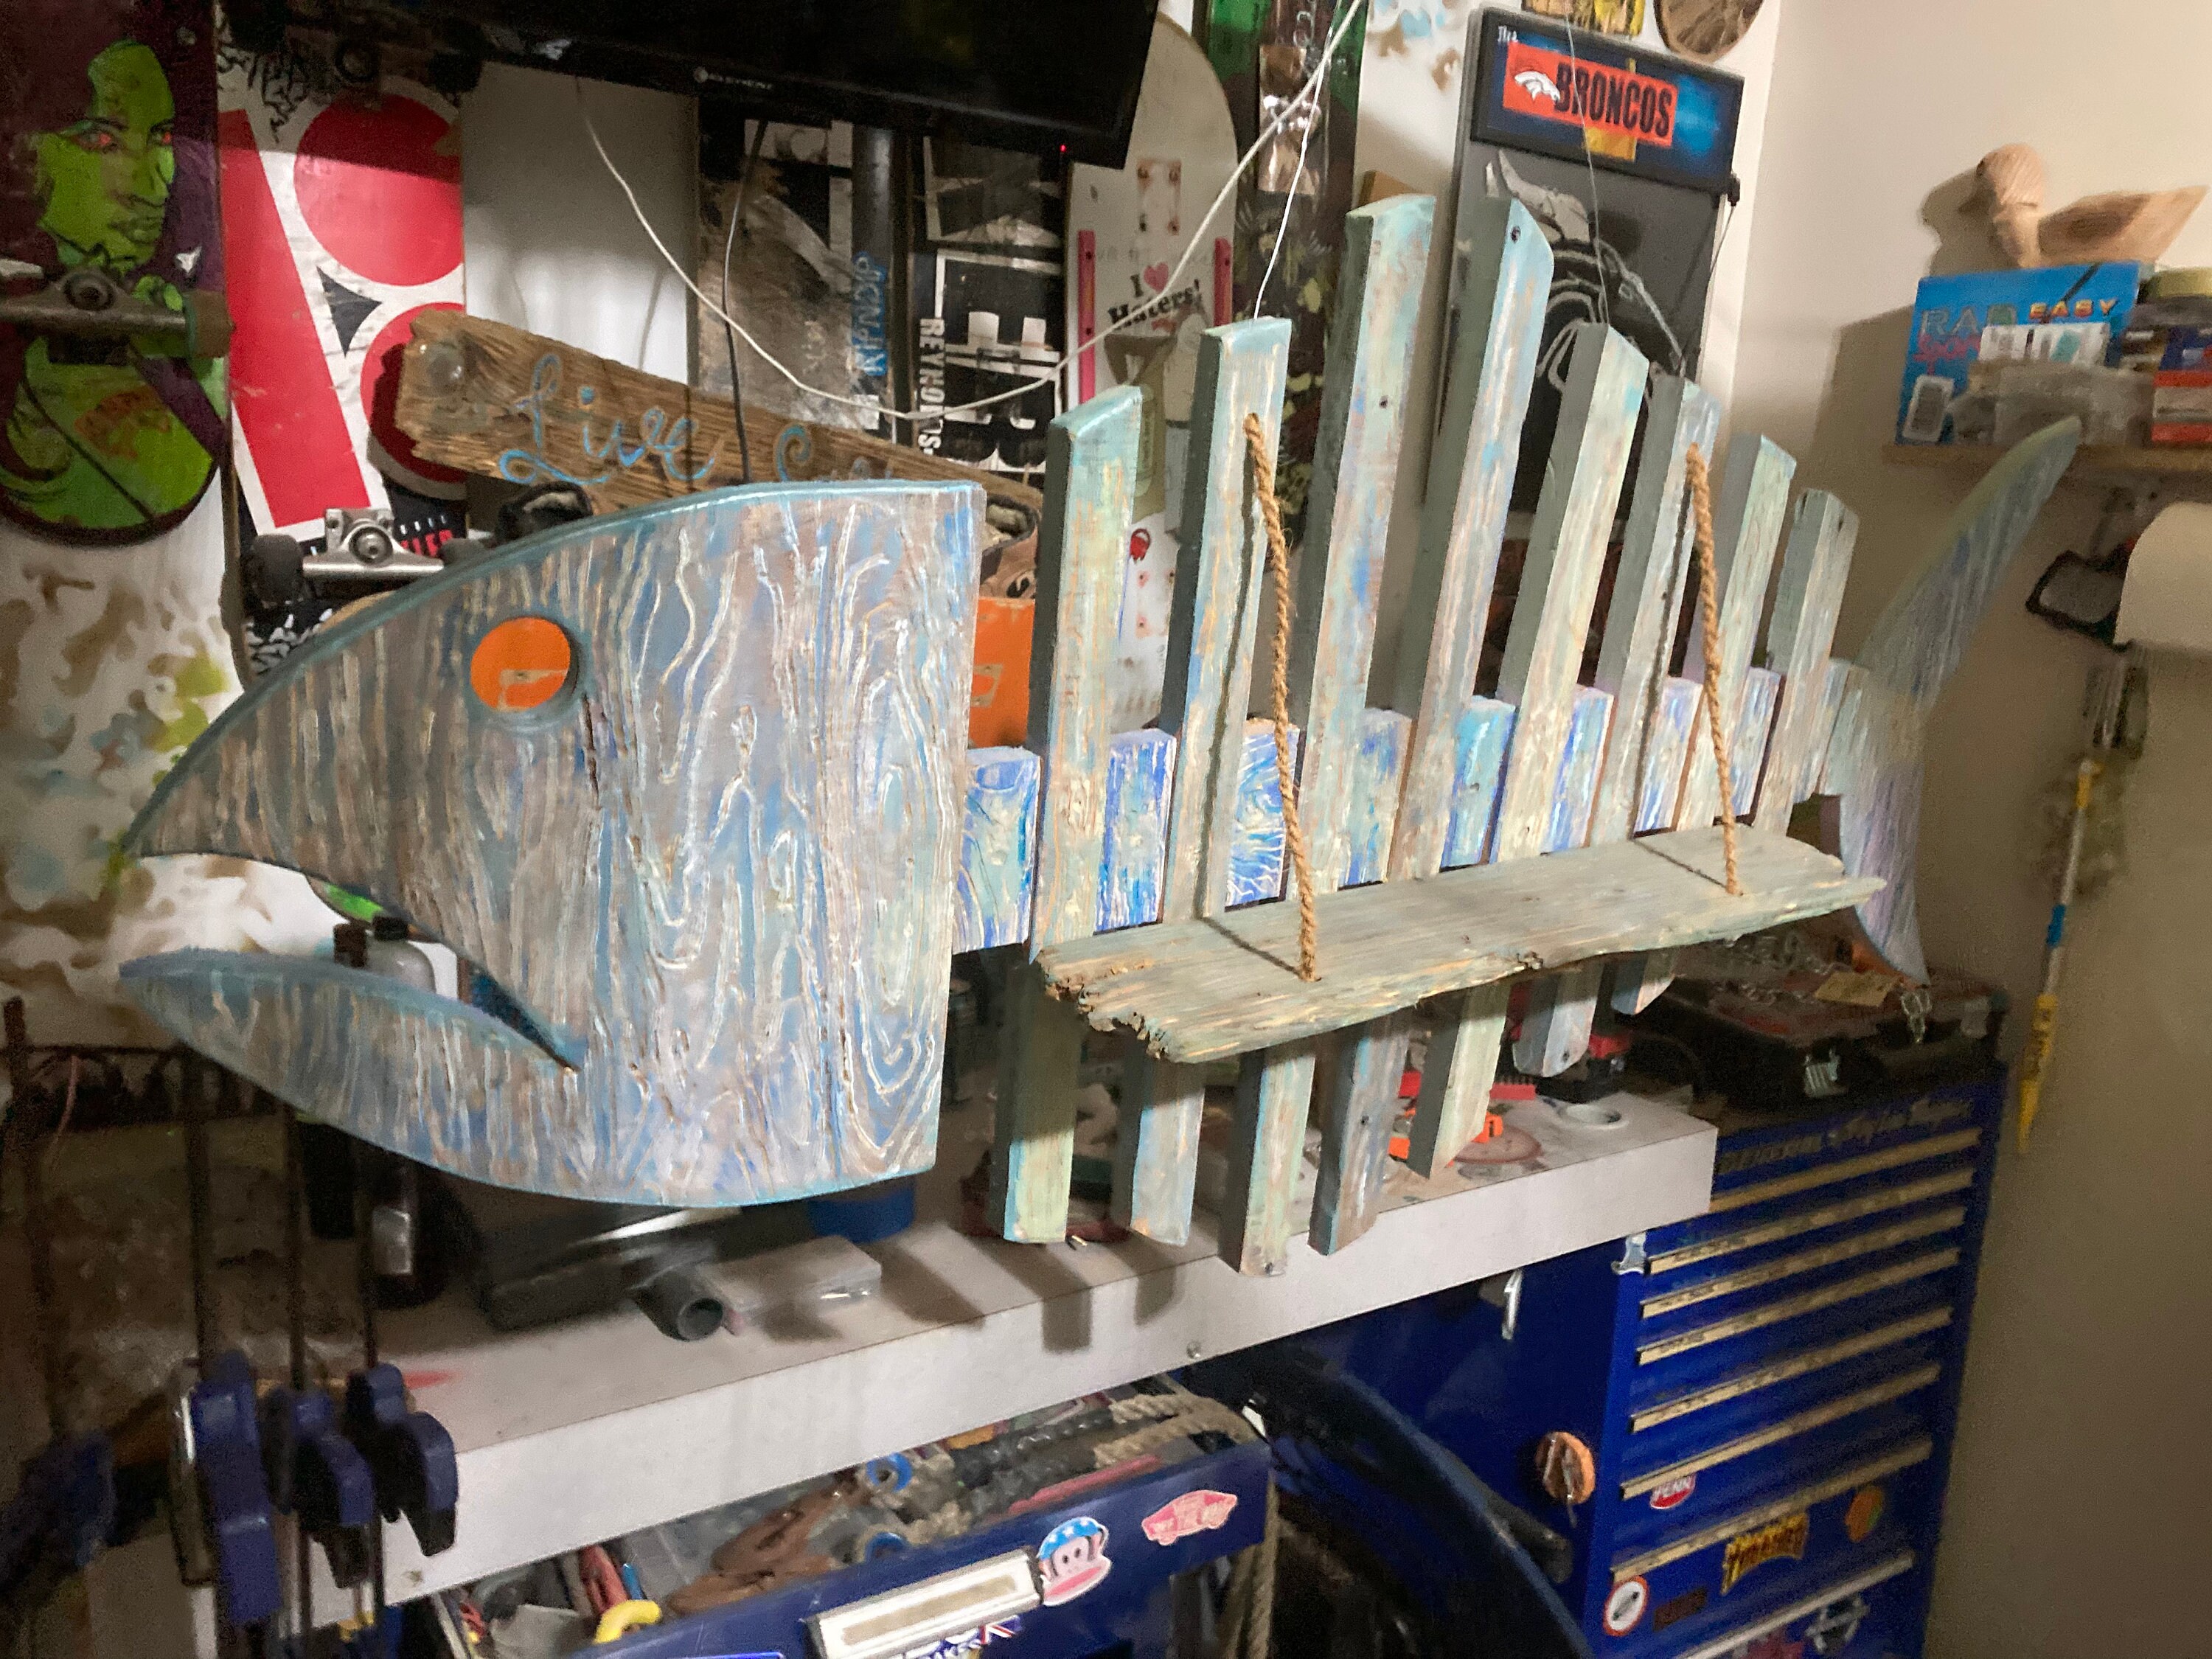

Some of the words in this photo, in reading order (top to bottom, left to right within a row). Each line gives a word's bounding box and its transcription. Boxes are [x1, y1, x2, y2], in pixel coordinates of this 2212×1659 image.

[1554, 62, 1672, 137] BRONCOS
[1130, 274, 1144, 298] I
[498, 352, 726, 486] Live
